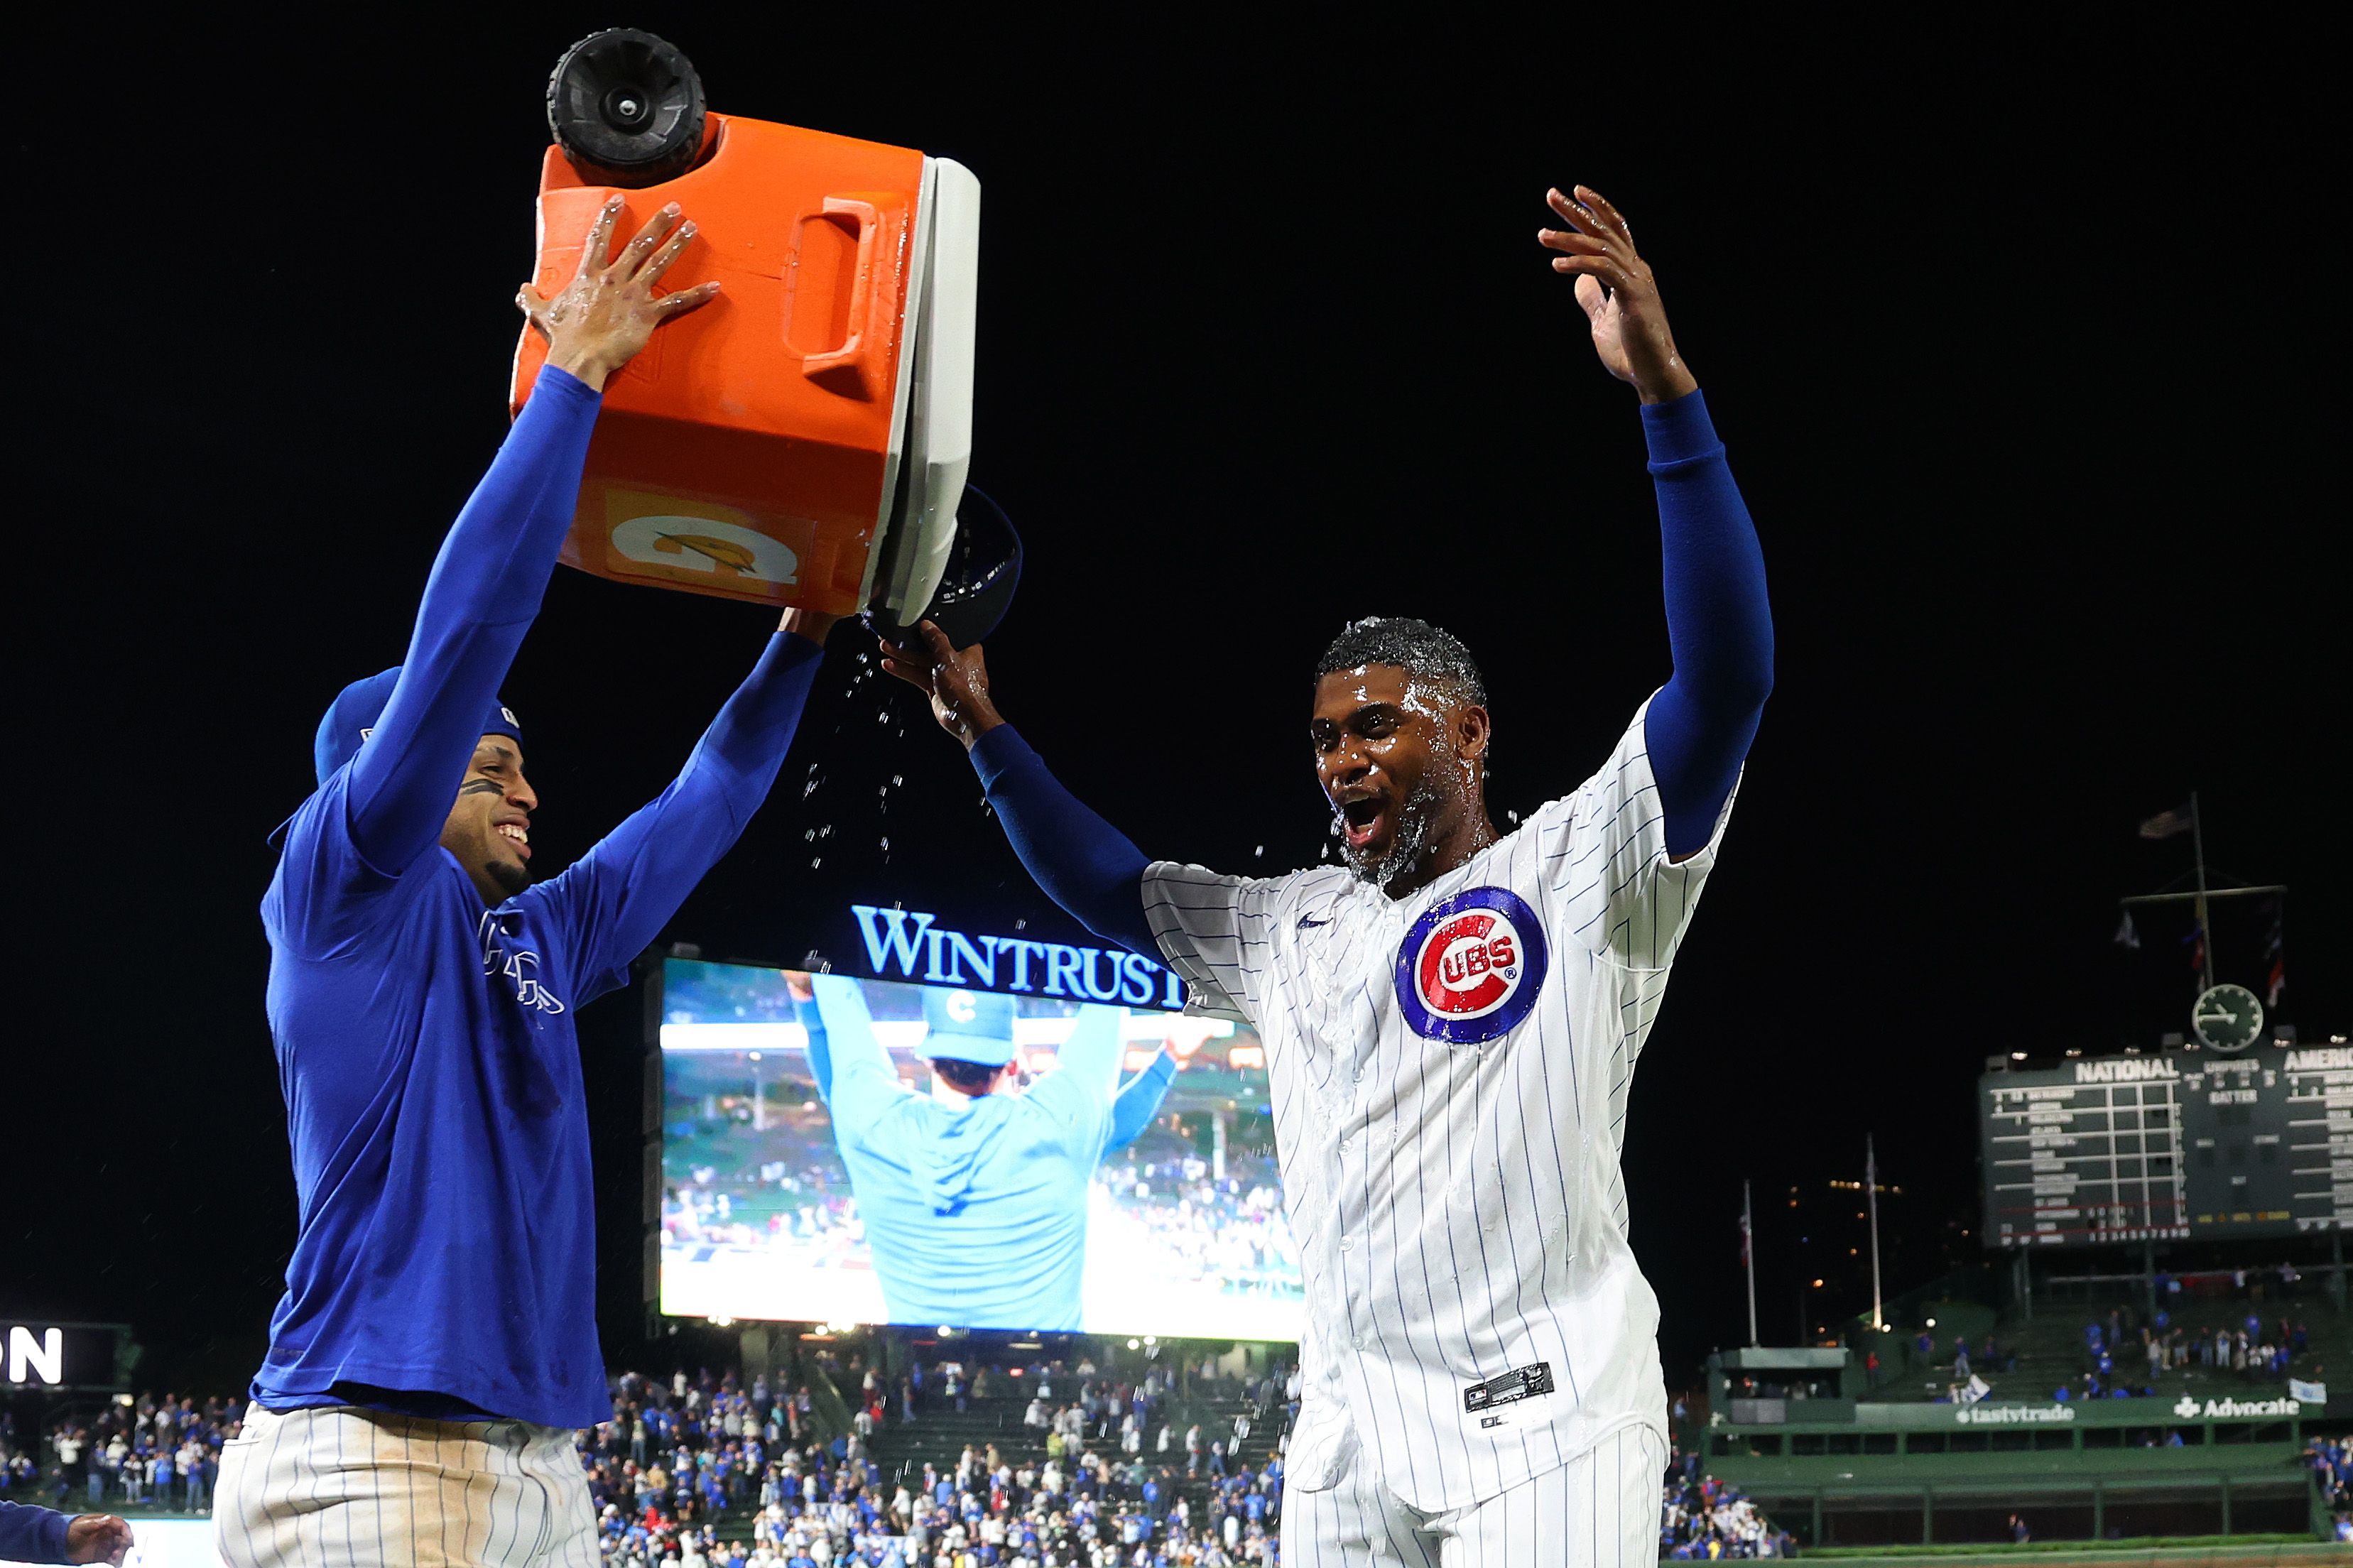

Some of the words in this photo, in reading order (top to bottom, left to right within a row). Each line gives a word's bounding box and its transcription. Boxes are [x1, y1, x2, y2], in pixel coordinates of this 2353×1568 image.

[852, 905, 1185, 1008] WINTRUST
[2075, 1058, 2180, 1083] NATIONAL
[0, 1326, 63, 1384] N
[2203, 1397, 2300, 1417] Advocate
